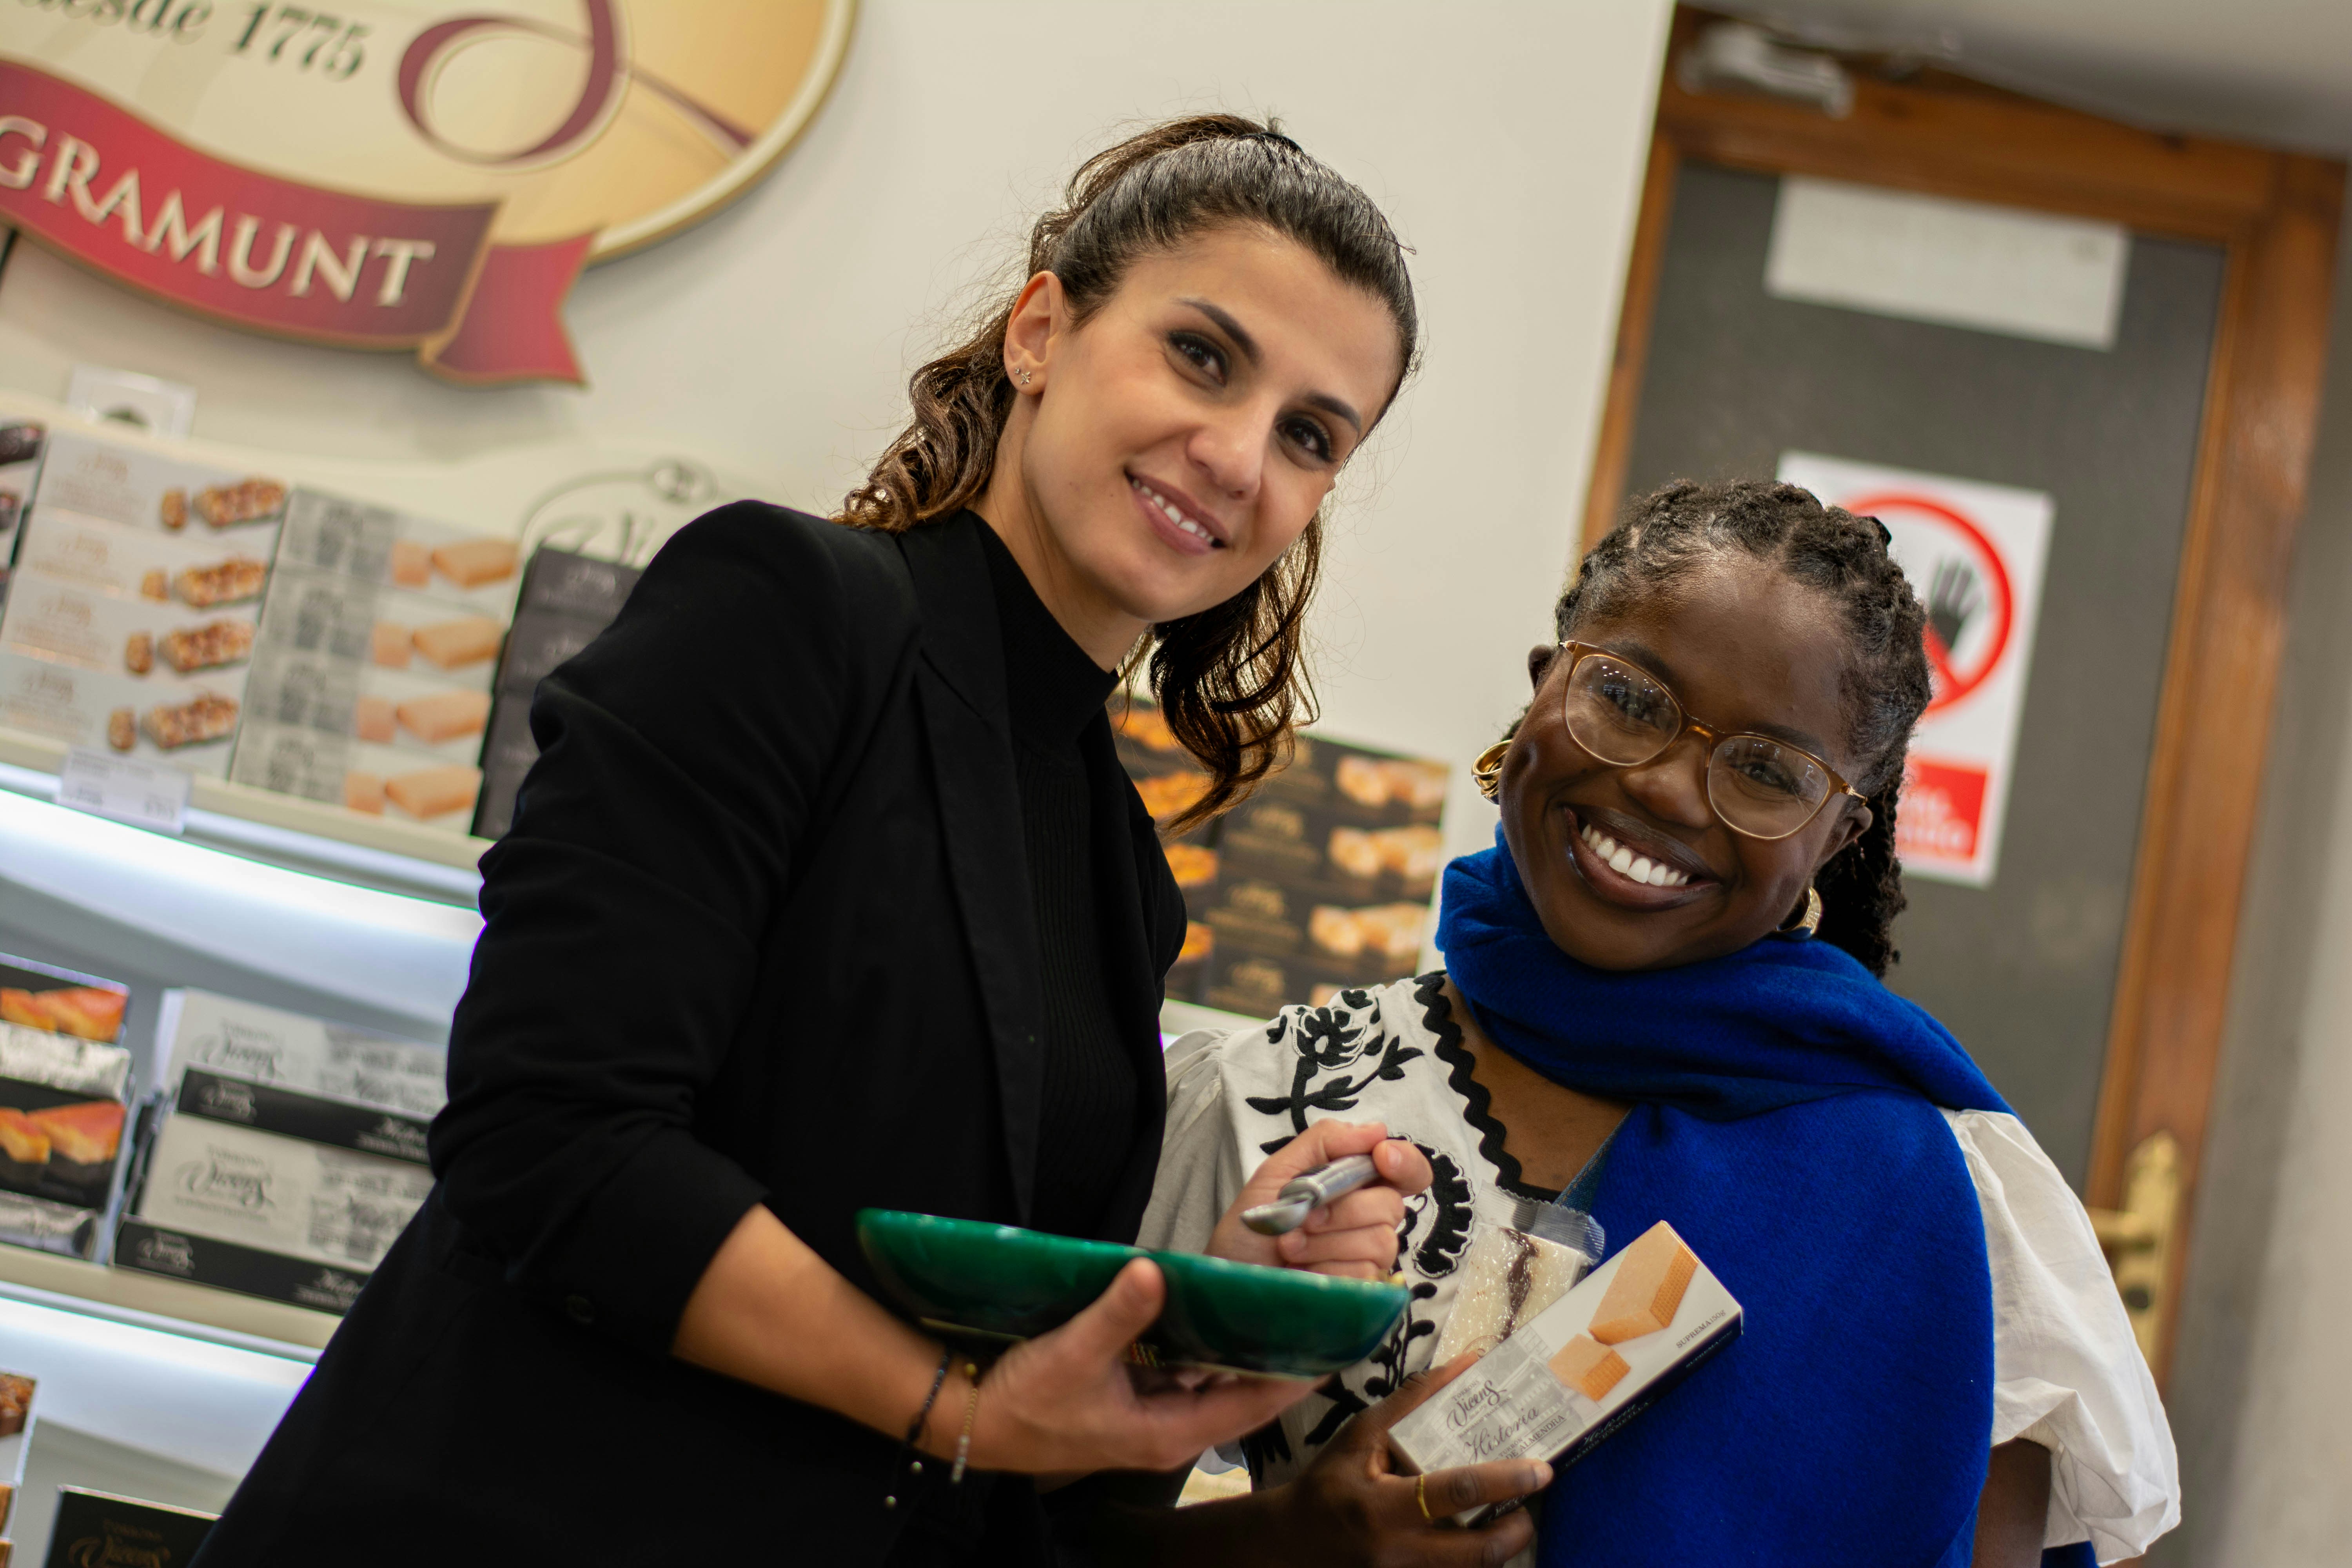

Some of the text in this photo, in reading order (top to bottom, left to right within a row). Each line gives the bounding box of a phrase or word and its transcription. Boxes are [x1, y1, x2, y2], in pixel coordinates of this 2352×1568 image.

[230, 3, 369, 81] 1775
[0, 115, 436, 307] GRAMUNT
[1446, 1379, 1507, 1431] Vicens
[1519, 1414, 1565, 1452] ALMENDRA
[1463, 1406, 1539, 1465] Historia
